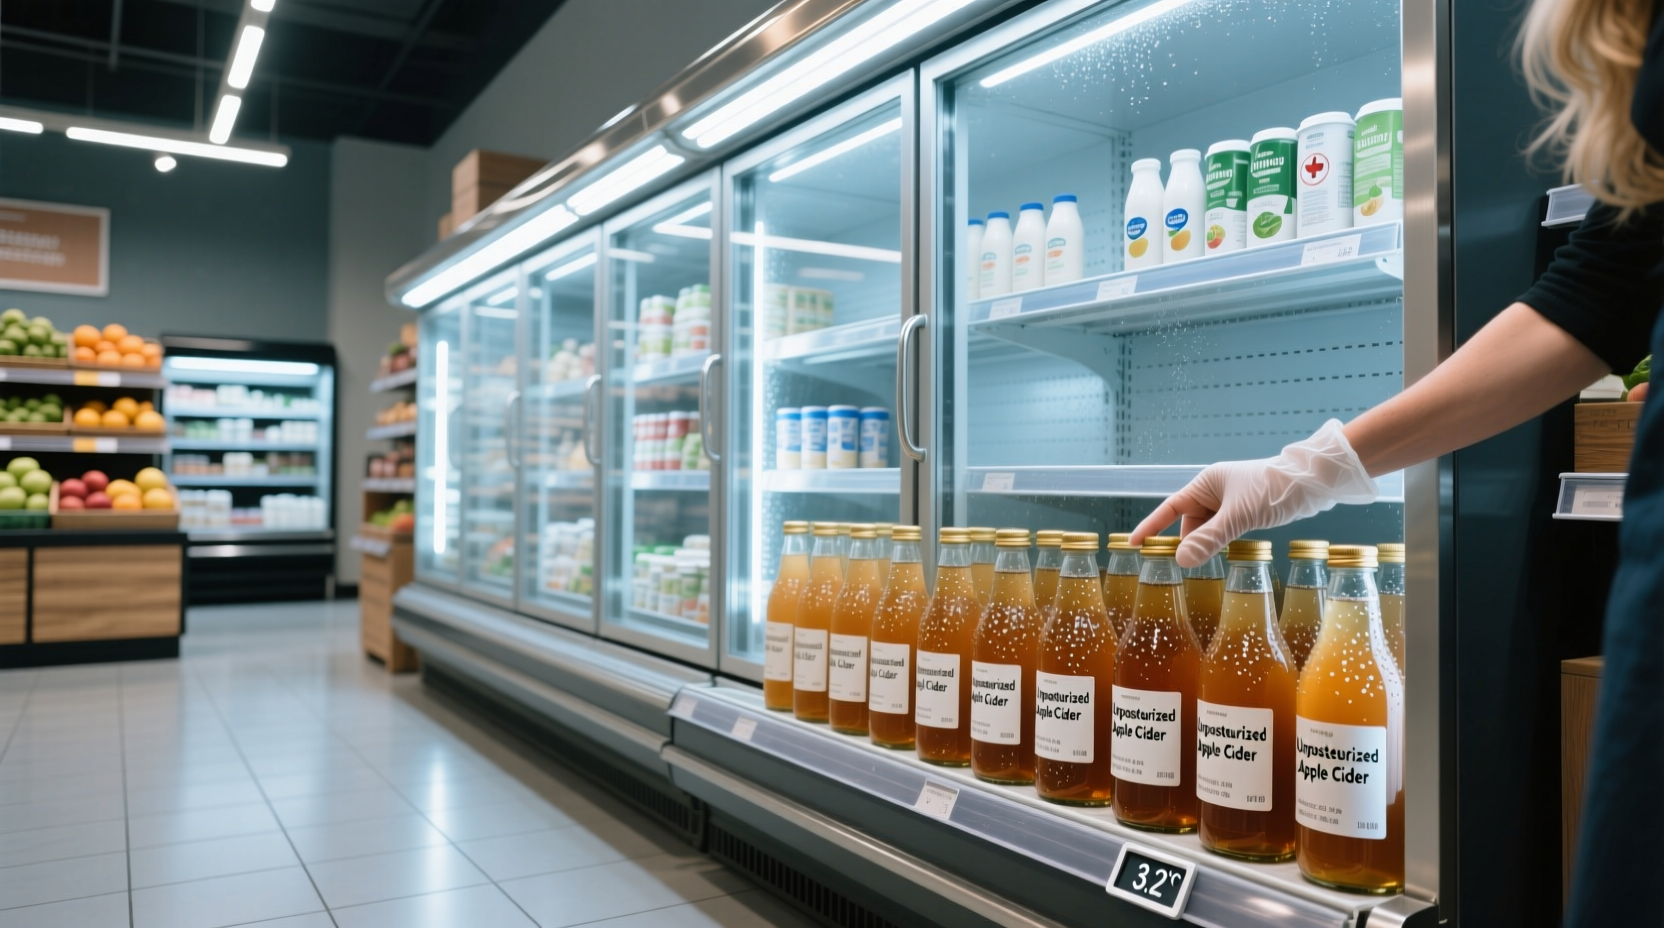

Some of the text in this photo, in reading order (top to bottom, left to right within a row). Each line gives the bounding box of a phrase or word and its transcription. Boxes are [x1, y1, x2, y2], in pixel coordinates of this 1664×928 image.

[984, 693, 1008, 706] Cider
[1054, 706, 1082, 721] Cider
[1134, 725, 1167, 741] Cider
[1198, 738, 1257, 762] Apple Cider
[1297, 759, 1370, 784] Apple Cider
